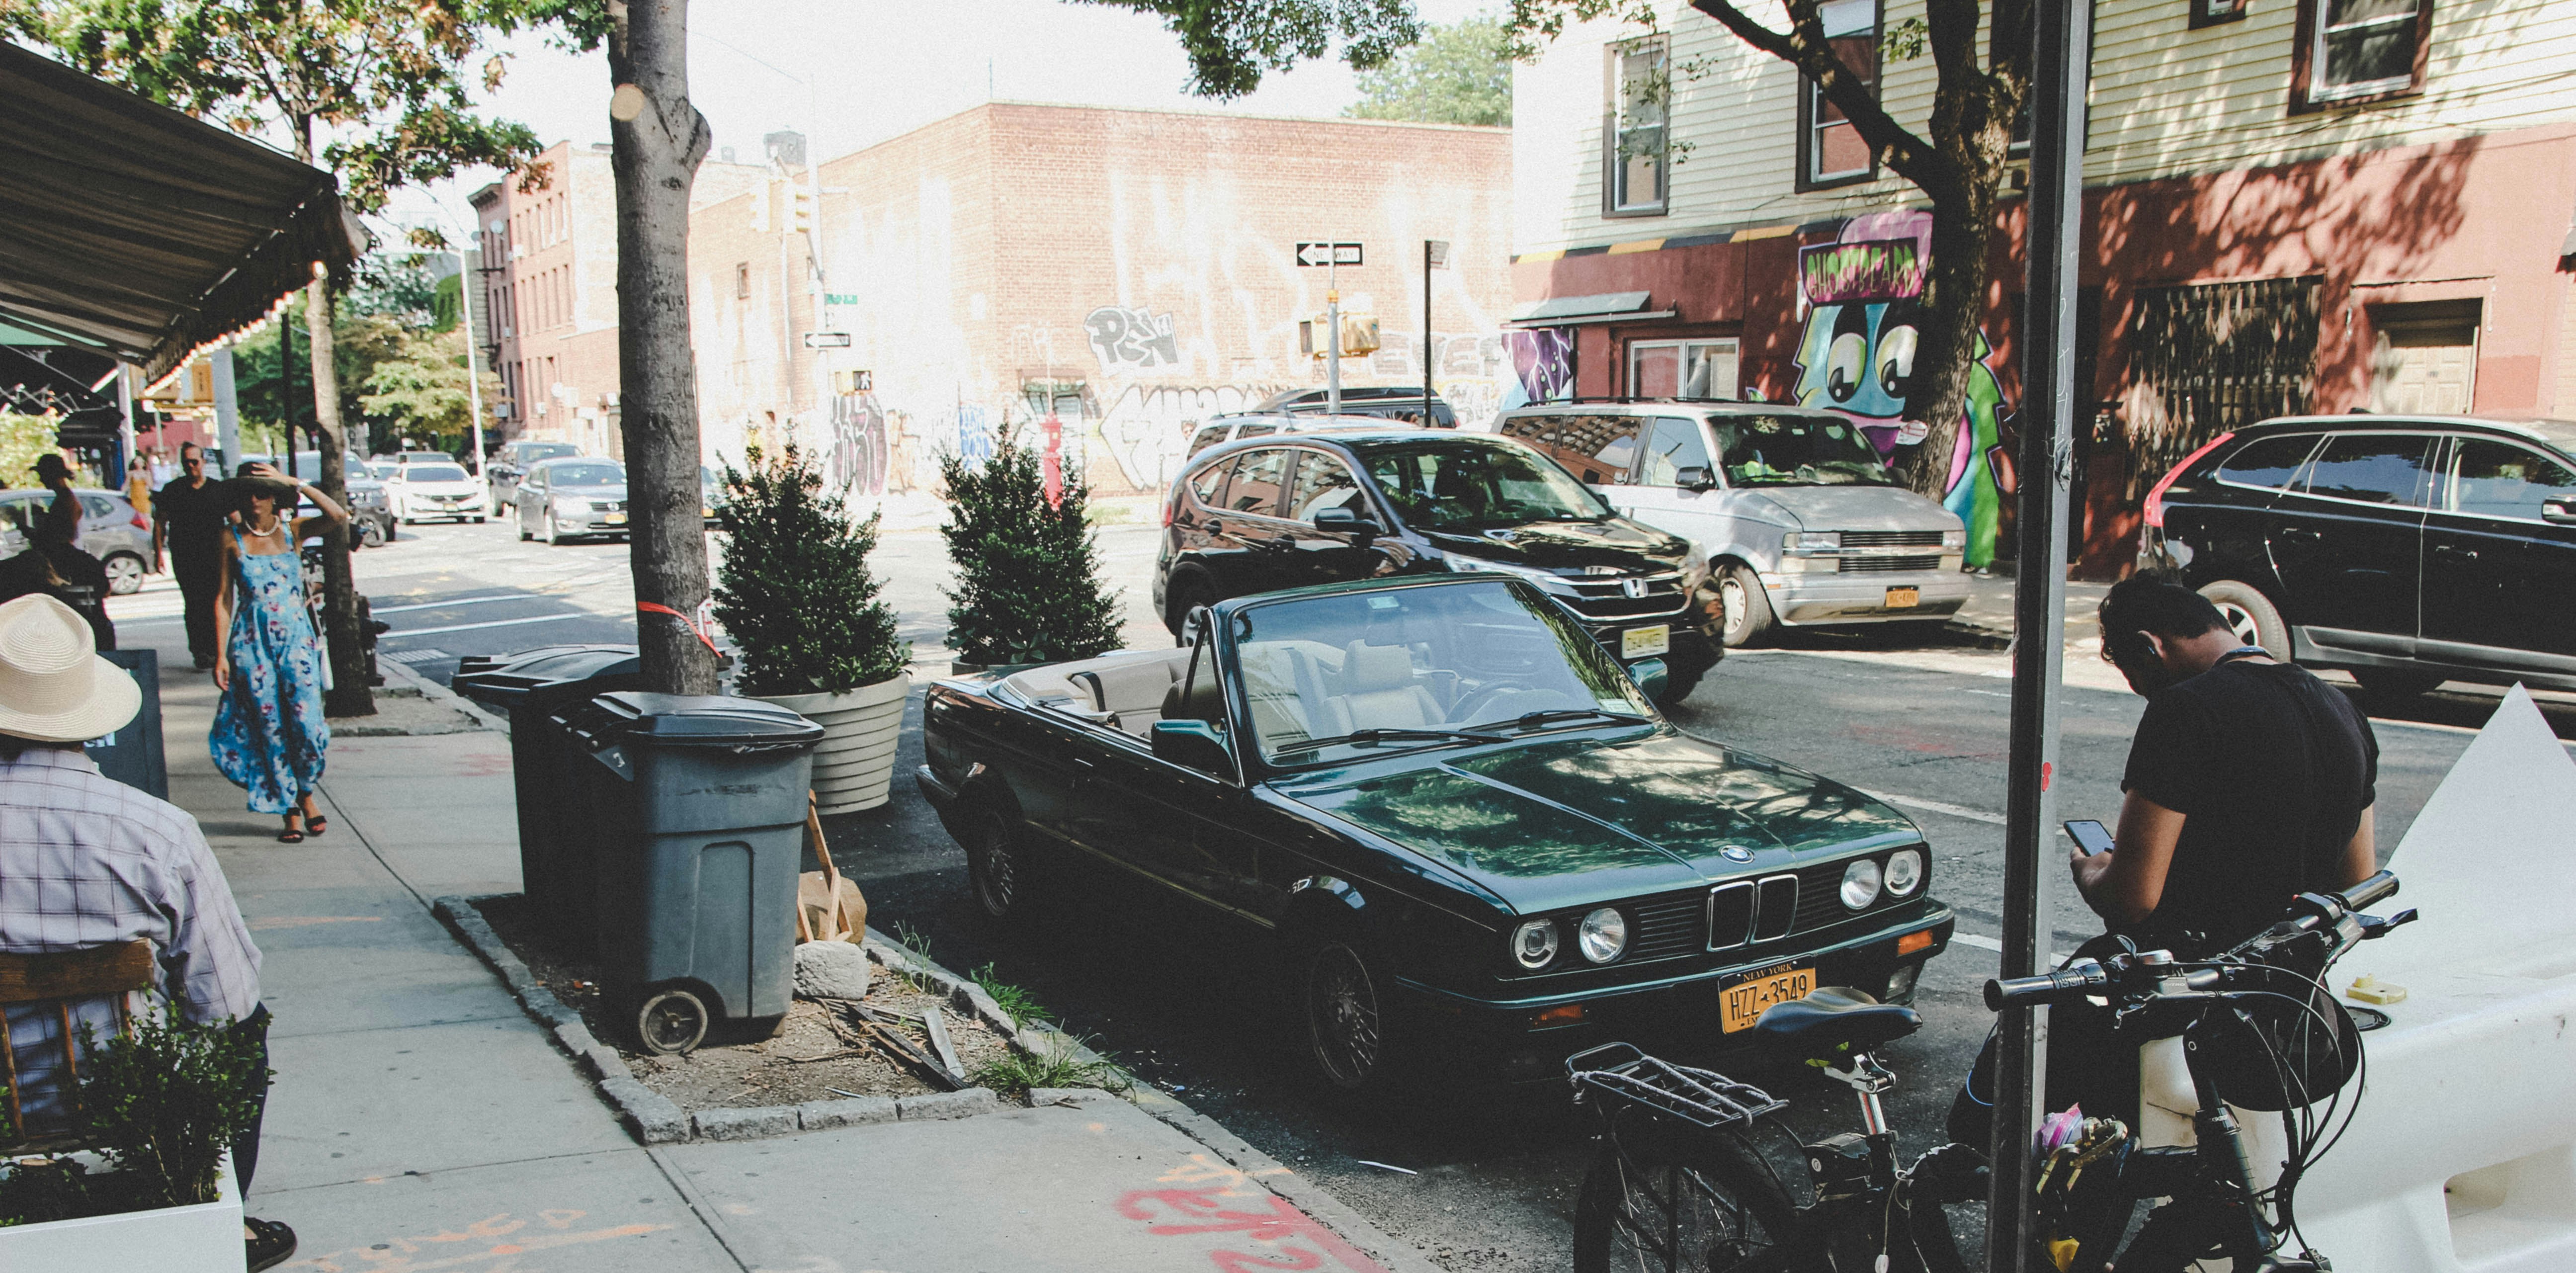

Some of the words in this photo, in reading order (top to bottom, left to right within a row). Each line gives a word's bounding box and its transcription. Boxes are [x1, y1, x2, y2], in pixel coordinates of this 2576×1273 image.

[1307, 251, 1325, 259] ONE
[1807, 245, 1915, 298] GHOSTBEARD
[1743, 970, 1765, 982] NEW
[1769, 963, 1792, 975] YORK
[1730, 984, 1760, 1021] HZZ
[1769, 974, 1807, 1003] 3549
